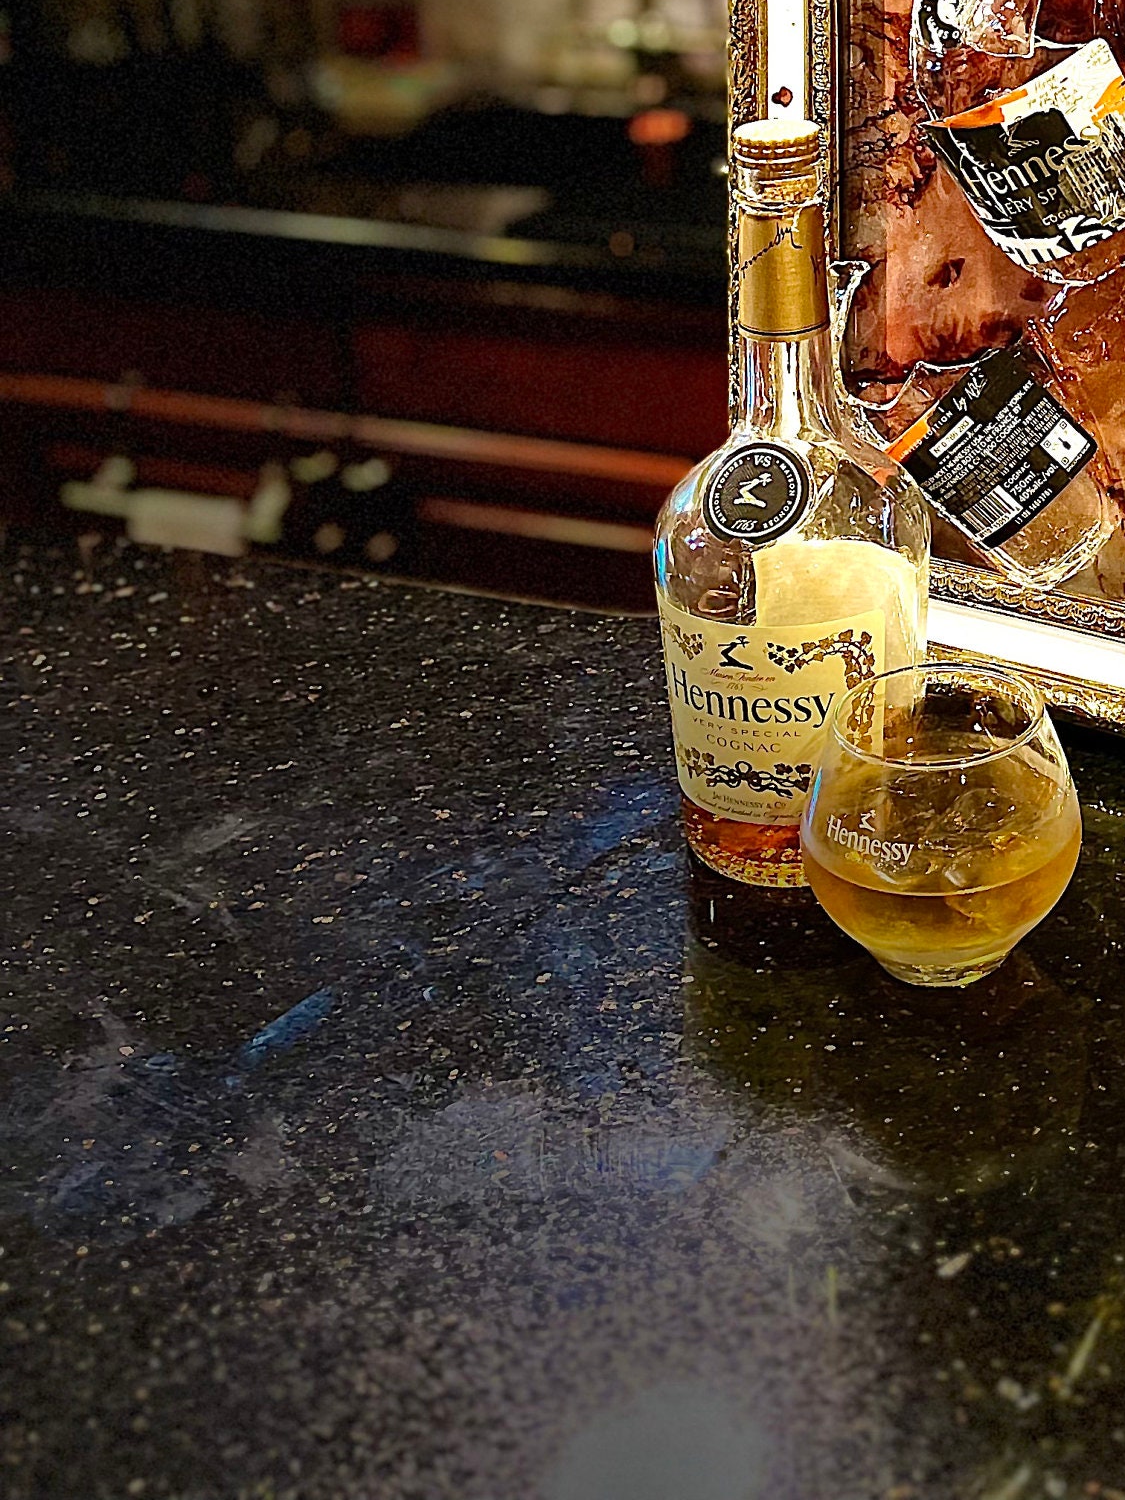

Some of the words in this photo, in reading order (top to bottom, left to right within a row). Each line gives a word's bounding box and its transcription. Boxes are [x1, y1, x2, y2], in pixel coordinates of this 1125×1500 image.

[991, 412, 1016, 436] FRANCE
[1012, 403, 1021, 414] BY
[995, 416, 1021, 442] COGNAC
[1003, 461, 1030, 488] COGNAC
[1010, 470, 1036, 495] 750ml
[731, 519, 758, 531] 1765
[672, 662, 836, 729] Hennessy
[692, 716, 724, 730] VERY
[730, 727, 802, 738] SPECIAL
[706, 733, 782, 754] COGNAC
[826, 814, 915, 866] Hennessy
